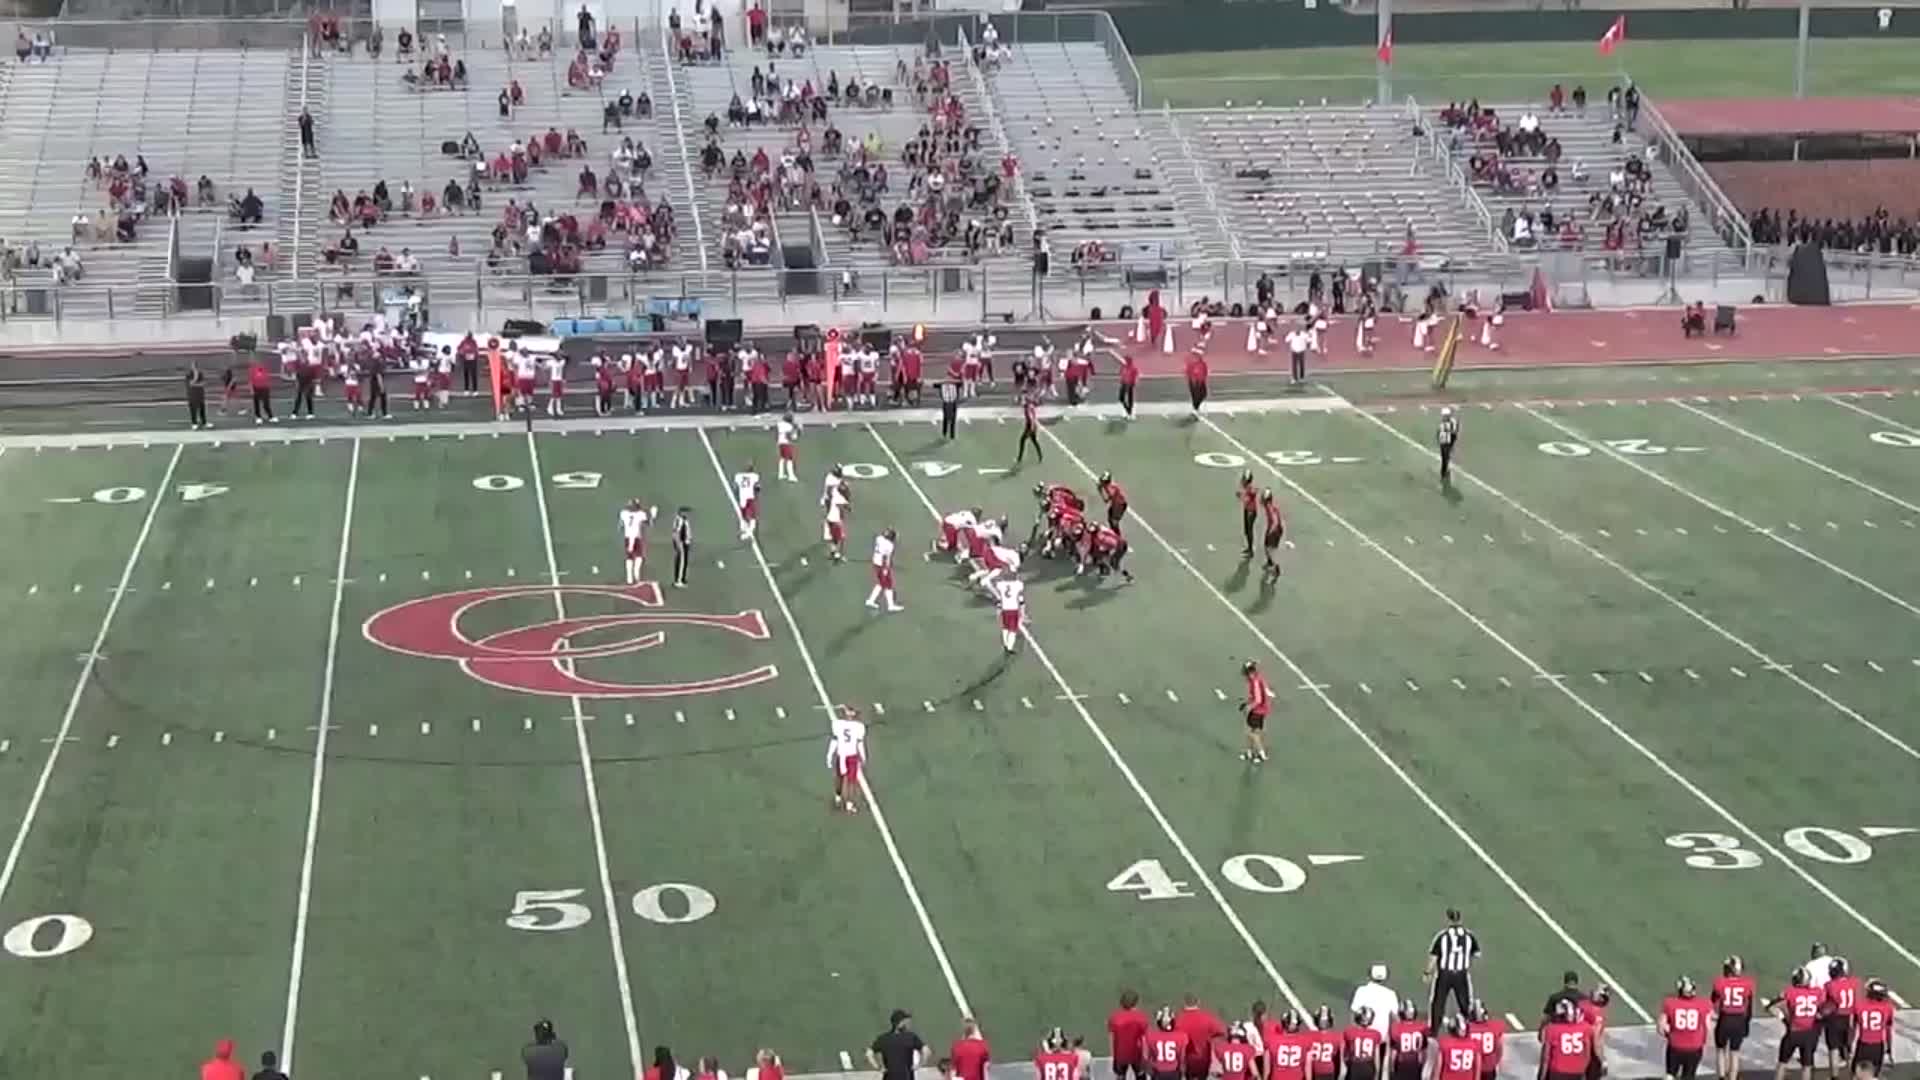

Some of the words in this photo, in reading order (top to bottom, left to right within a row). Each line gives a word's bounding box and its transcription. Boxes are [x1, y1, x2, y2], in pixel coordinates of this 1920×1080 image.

[843, 728, 853, 742] 5
[1664, 826, 1873, 869] 30
[1108, 854, 1307, 899] 40
[505, 882, 716, 931] 50
[1723, 987, 1744, 1006] 15
[1795, 996, 1817, 1017] 25
[1839, 988, 1854, 1009] 11
[1675, 1008, 1699, 1030] 68
[1861, 1010, 1882, 1030] 12
[1156, 1041, 1177, 1061] 16
[1354, 1037, 1374, 1058] 19
[1561, 1032, 1584, 1054] 65
[1223, 1051, 1244, 1072] 18
[1277, 1044, 1302, 1067] 62
[1449, 1048, 1474, 1071] 58
